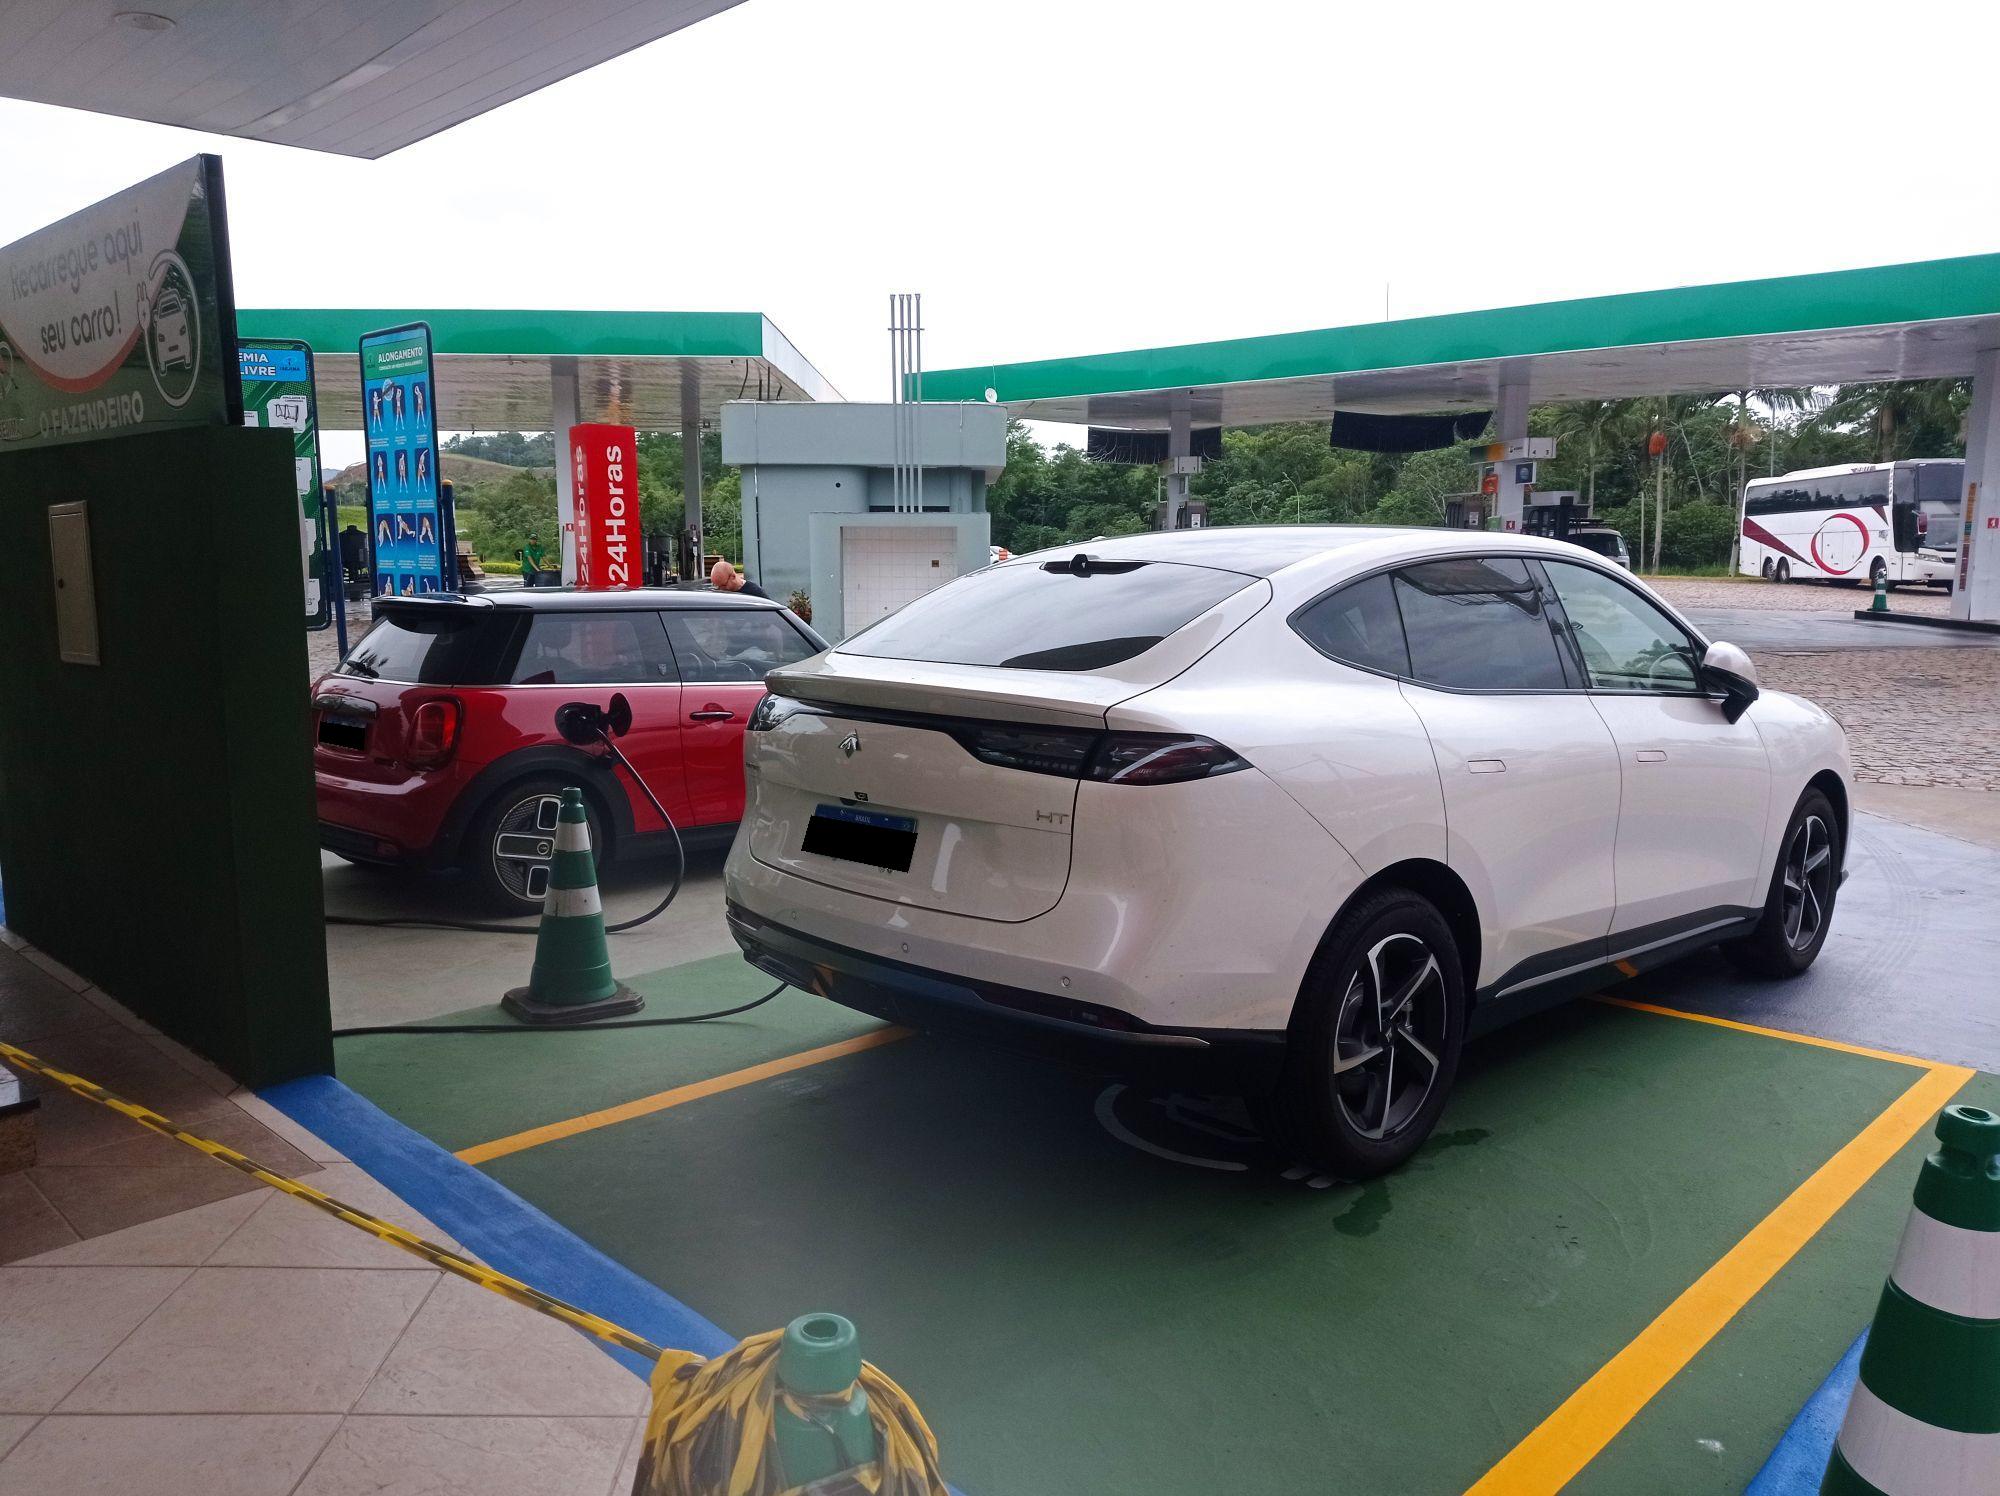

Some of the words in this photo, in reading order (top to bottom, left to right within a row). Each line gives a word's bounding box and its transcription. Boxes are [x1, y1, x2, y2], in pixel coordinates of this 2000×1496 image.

[10, 242, 98, 299] Recarregue
[103, 208, 142, 274] aqui
[41, 322, 66, 354] seu
[71, 291, 121, 343] carro!
[378, 347, 423, 363] ALONGAMENTO
[51, 391, 144, 437] FAZENDEIRO
[576, 445, 589, 583] 24Horas
[605, 445, 629, 582] 24Horas
[1036, 810, 1069, 825] HT
